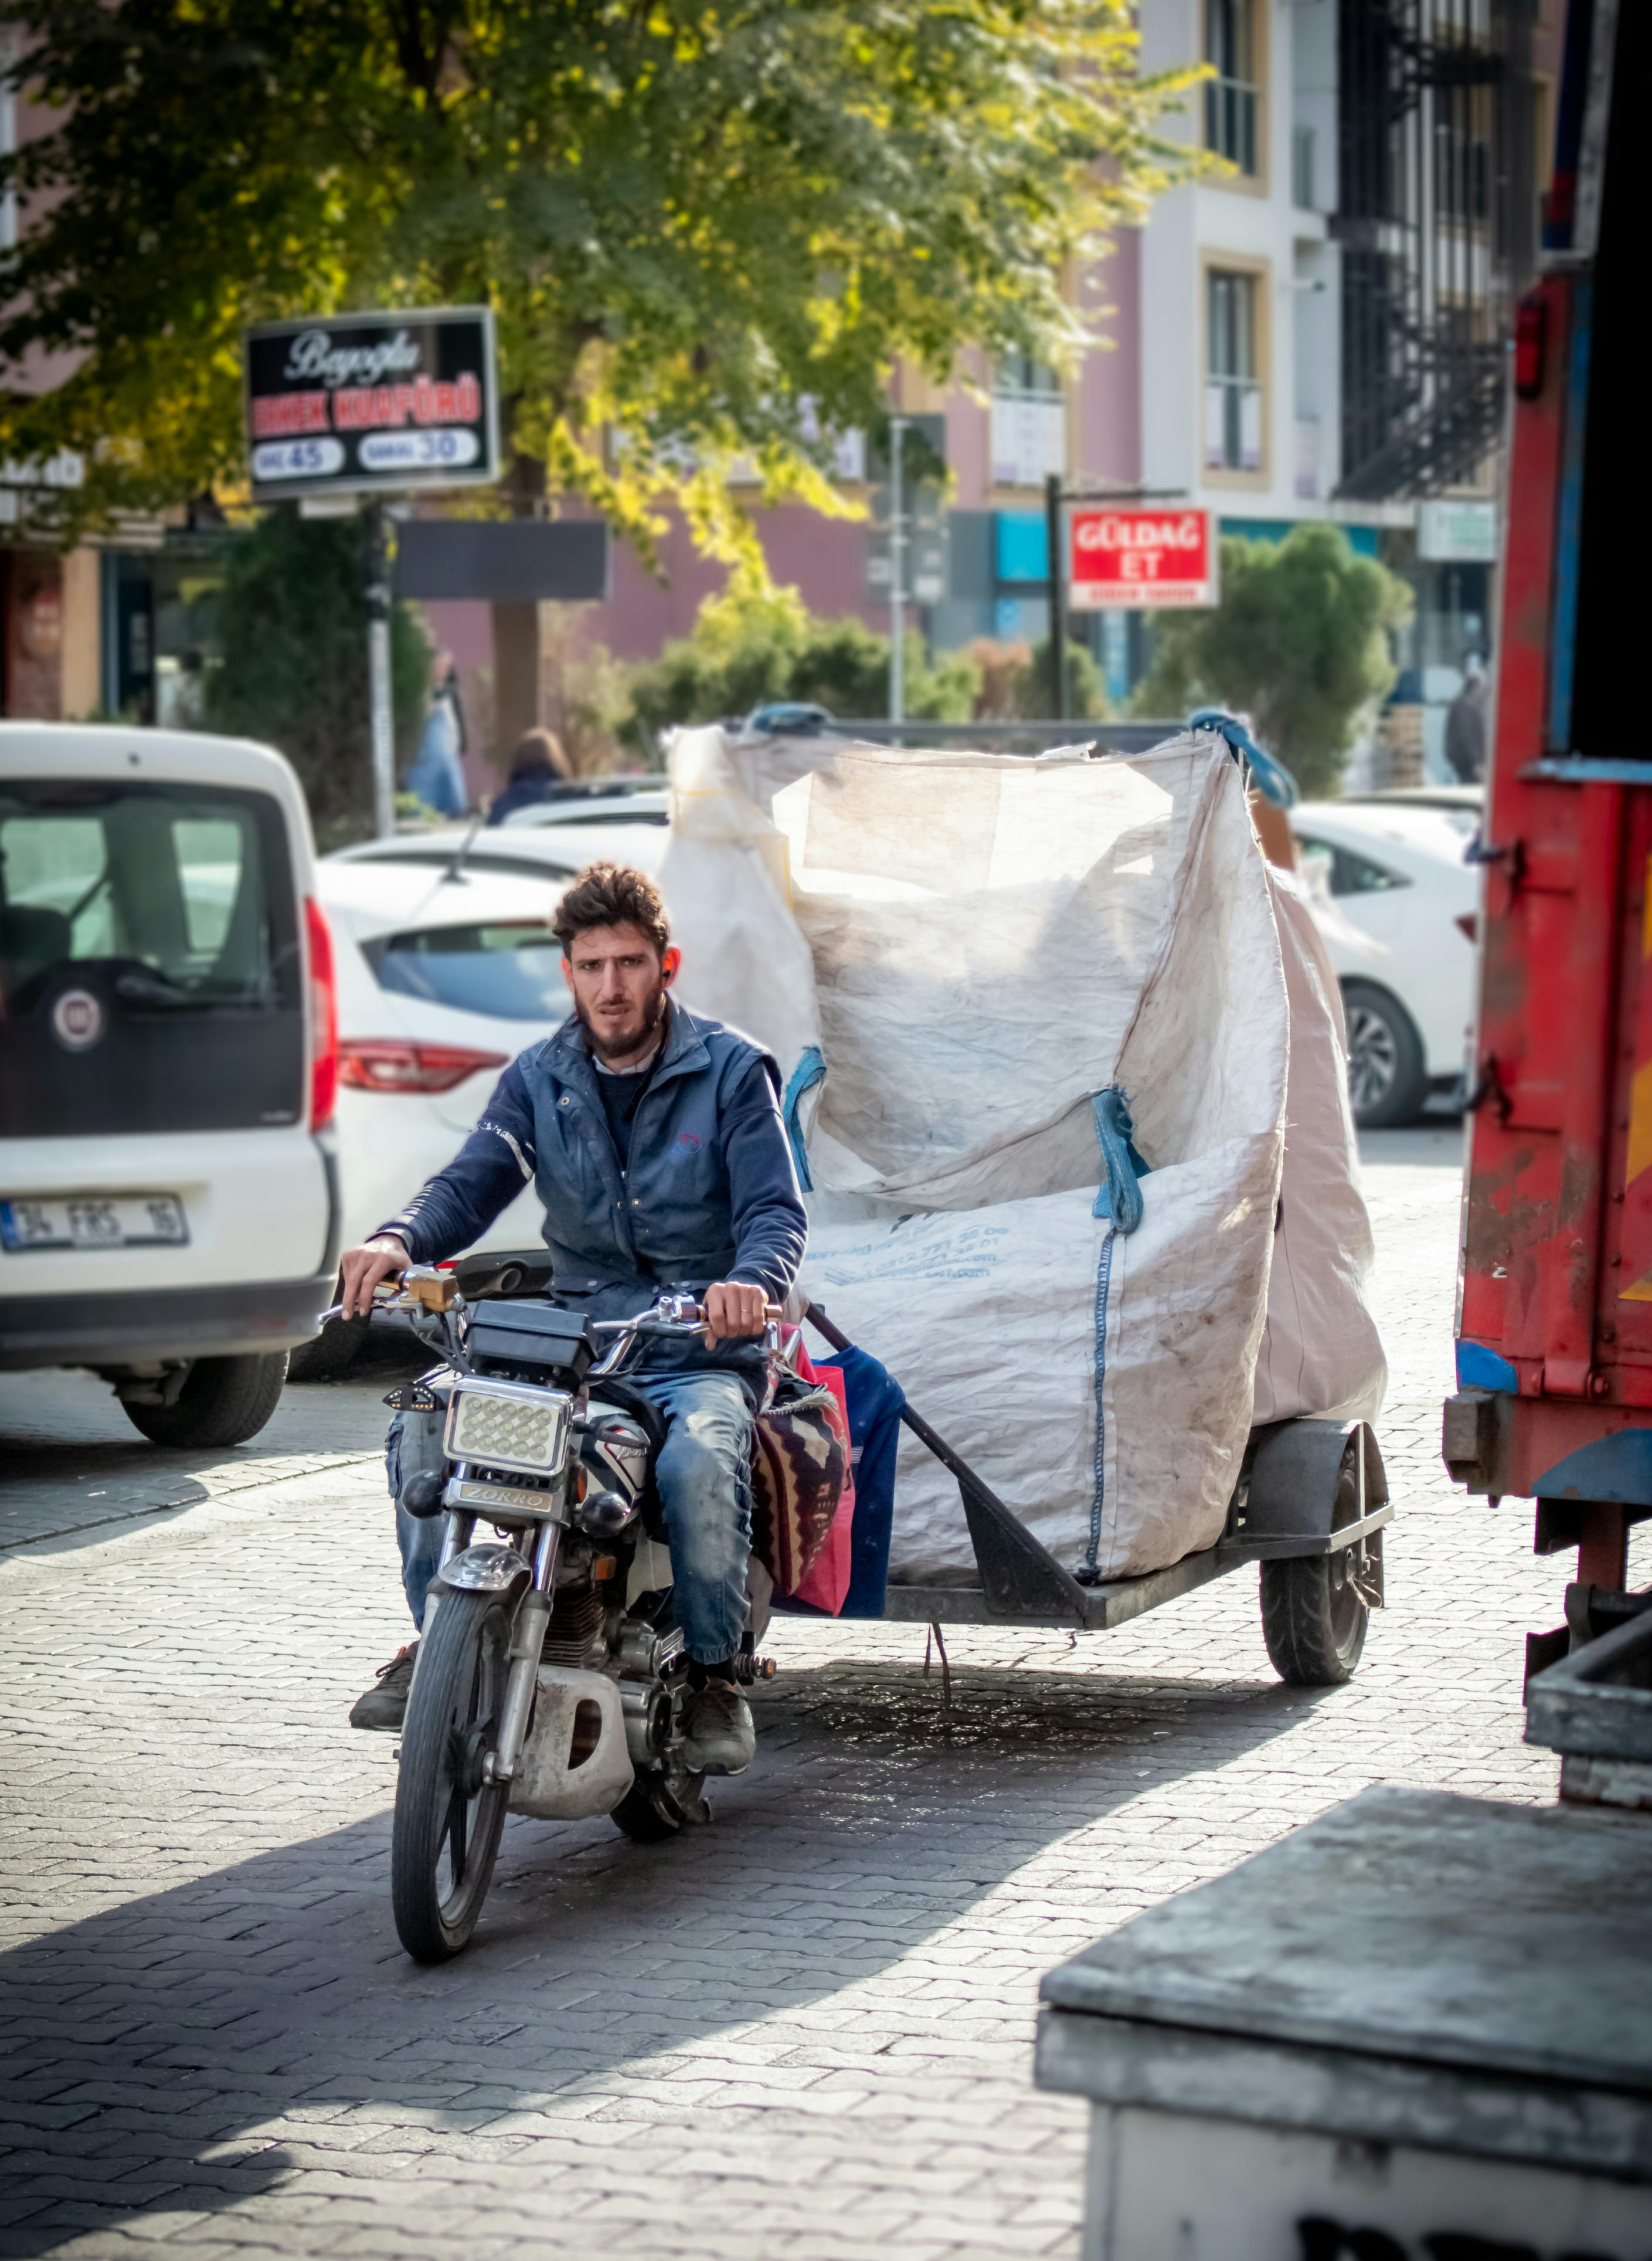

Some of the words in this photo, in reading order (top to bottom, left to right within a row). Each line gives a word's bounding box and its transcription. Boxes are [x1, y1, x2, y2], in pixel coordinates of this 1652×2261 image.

[1076, 514, 1201, 551] GÜLDAĞ
[1120, 550, 1165, 580] ET
[467, 1487, 543, 1506] ZORRO
